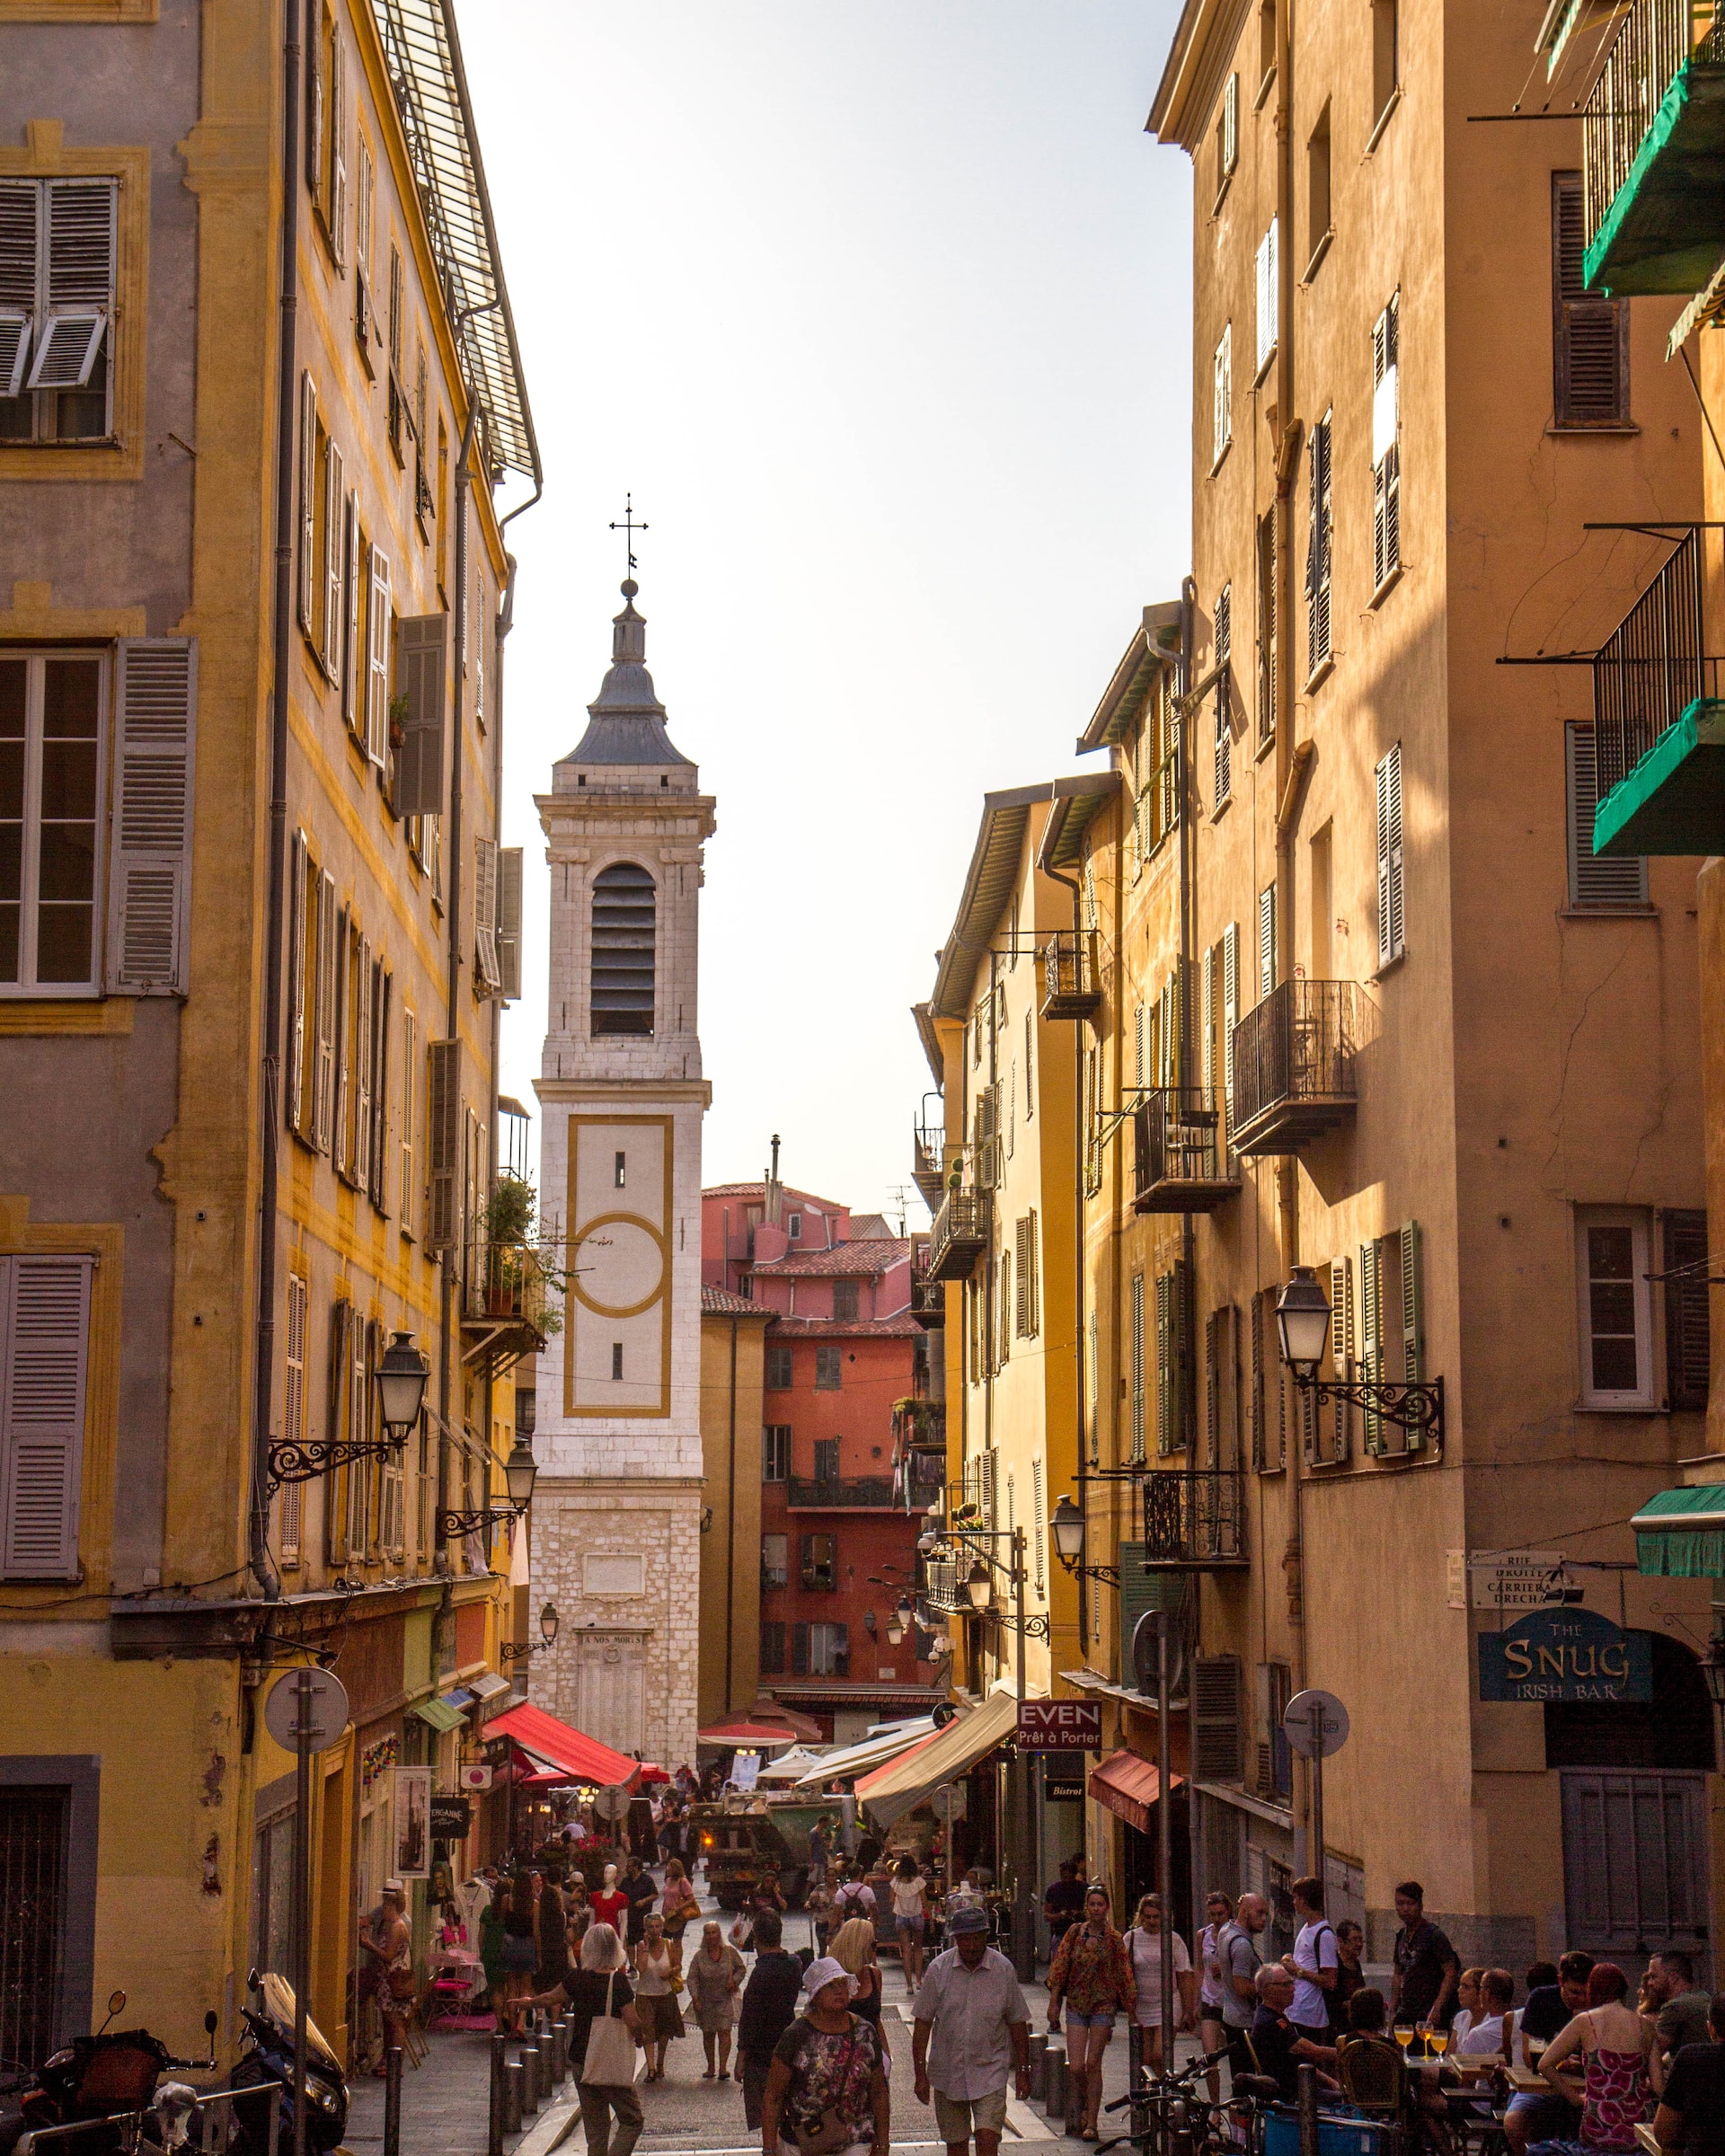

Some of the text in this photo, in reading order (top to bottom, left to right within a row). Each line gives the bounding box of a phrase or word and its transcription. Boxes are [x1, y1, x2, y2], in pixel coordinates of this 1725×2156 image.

[1508, 1557, 1531, 1565] RUE
[1550, 1623, 1581, 1637] THE
[594, 1636, 610, 1644] NOS
[1504, 1639, 1629, 1690] SNUG
[1517, 1683, 1618, 1700] IRISH BAR
[1021, 1705, 1099, 1726] EVEN
[1019, 1731, 1101, 1745] Prêt à Porter
[1053, 1786, 1083, 1796] Bistrot
